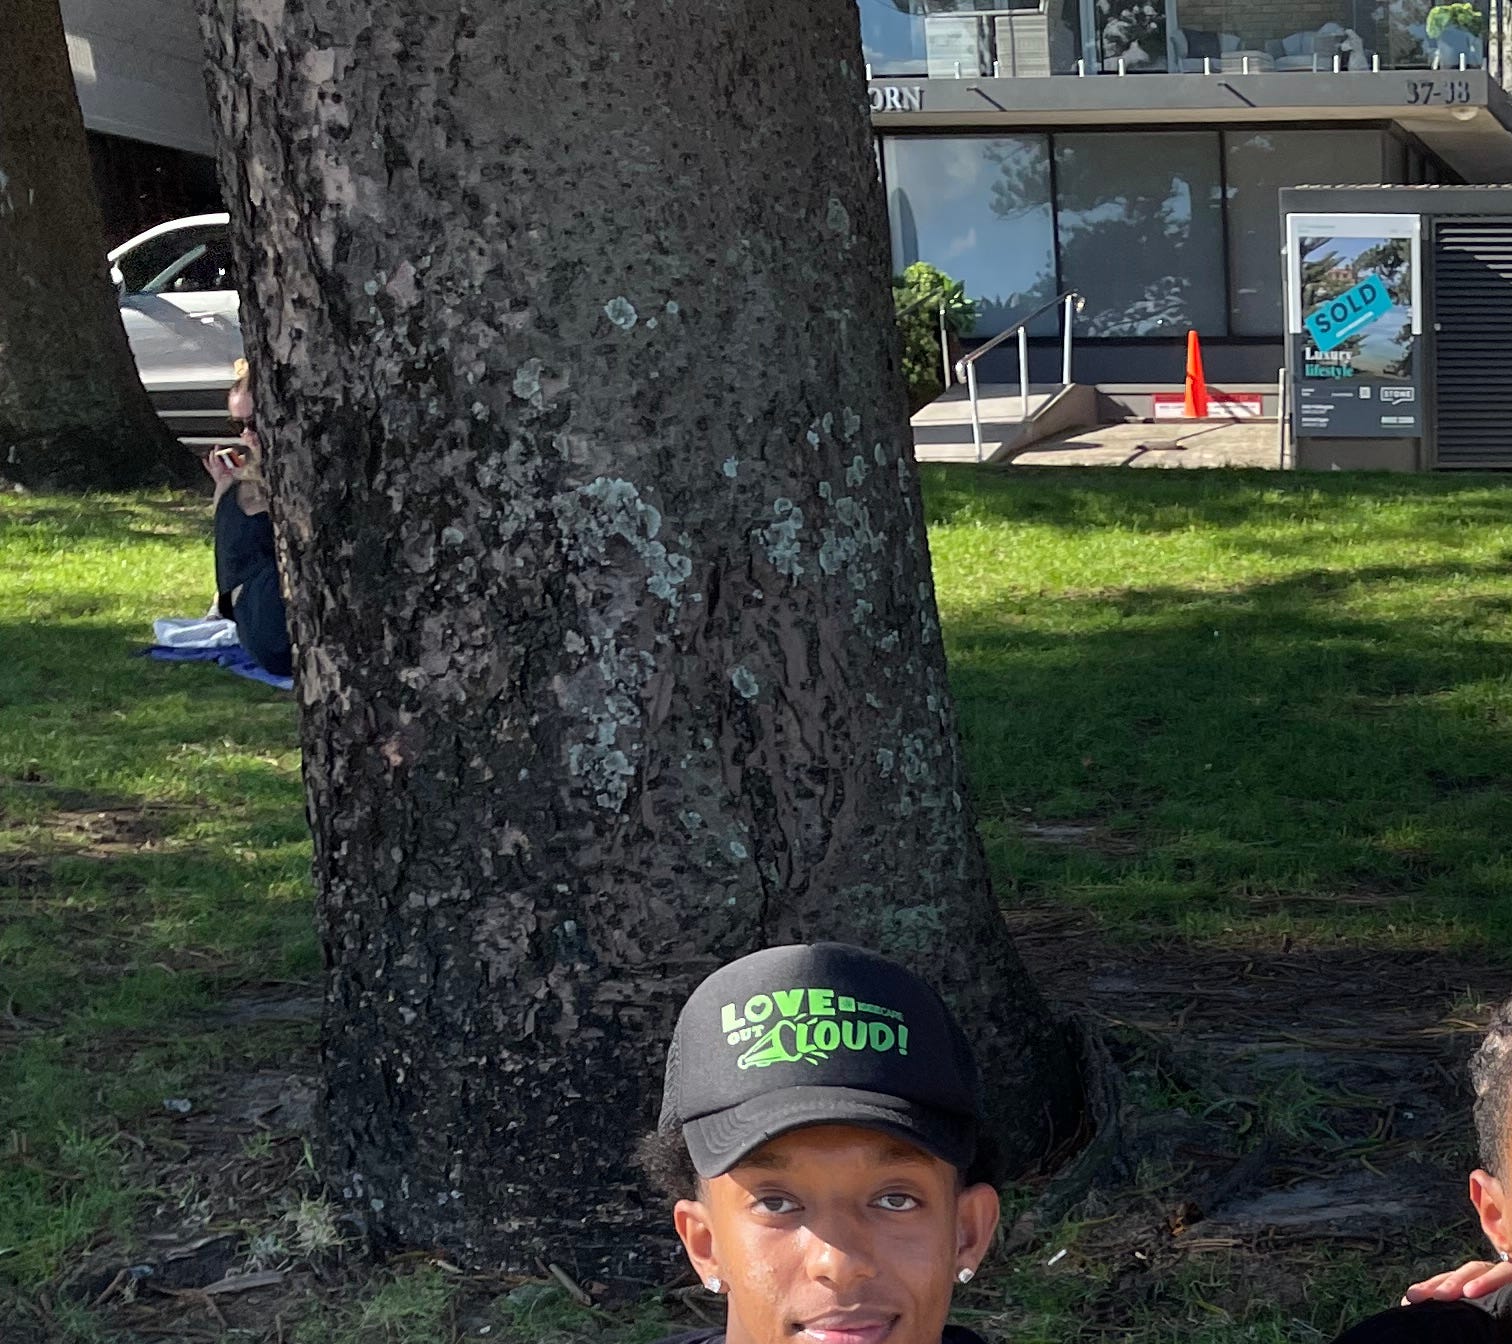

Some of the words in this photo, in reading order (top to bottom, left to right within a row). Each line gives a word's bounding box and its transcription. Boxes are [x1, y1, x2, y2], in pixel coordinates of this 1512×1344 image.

[867, 86, 921, 112] ORN
[1314, 283, 1378, 333] SOLD
[1304, 346, 1354, 364] Luxury
[1304, 363, 1355, 380] lifestyle
[721, 988, 836, 1034] LOVE
[726, 1024, 766, 1046] OUT
